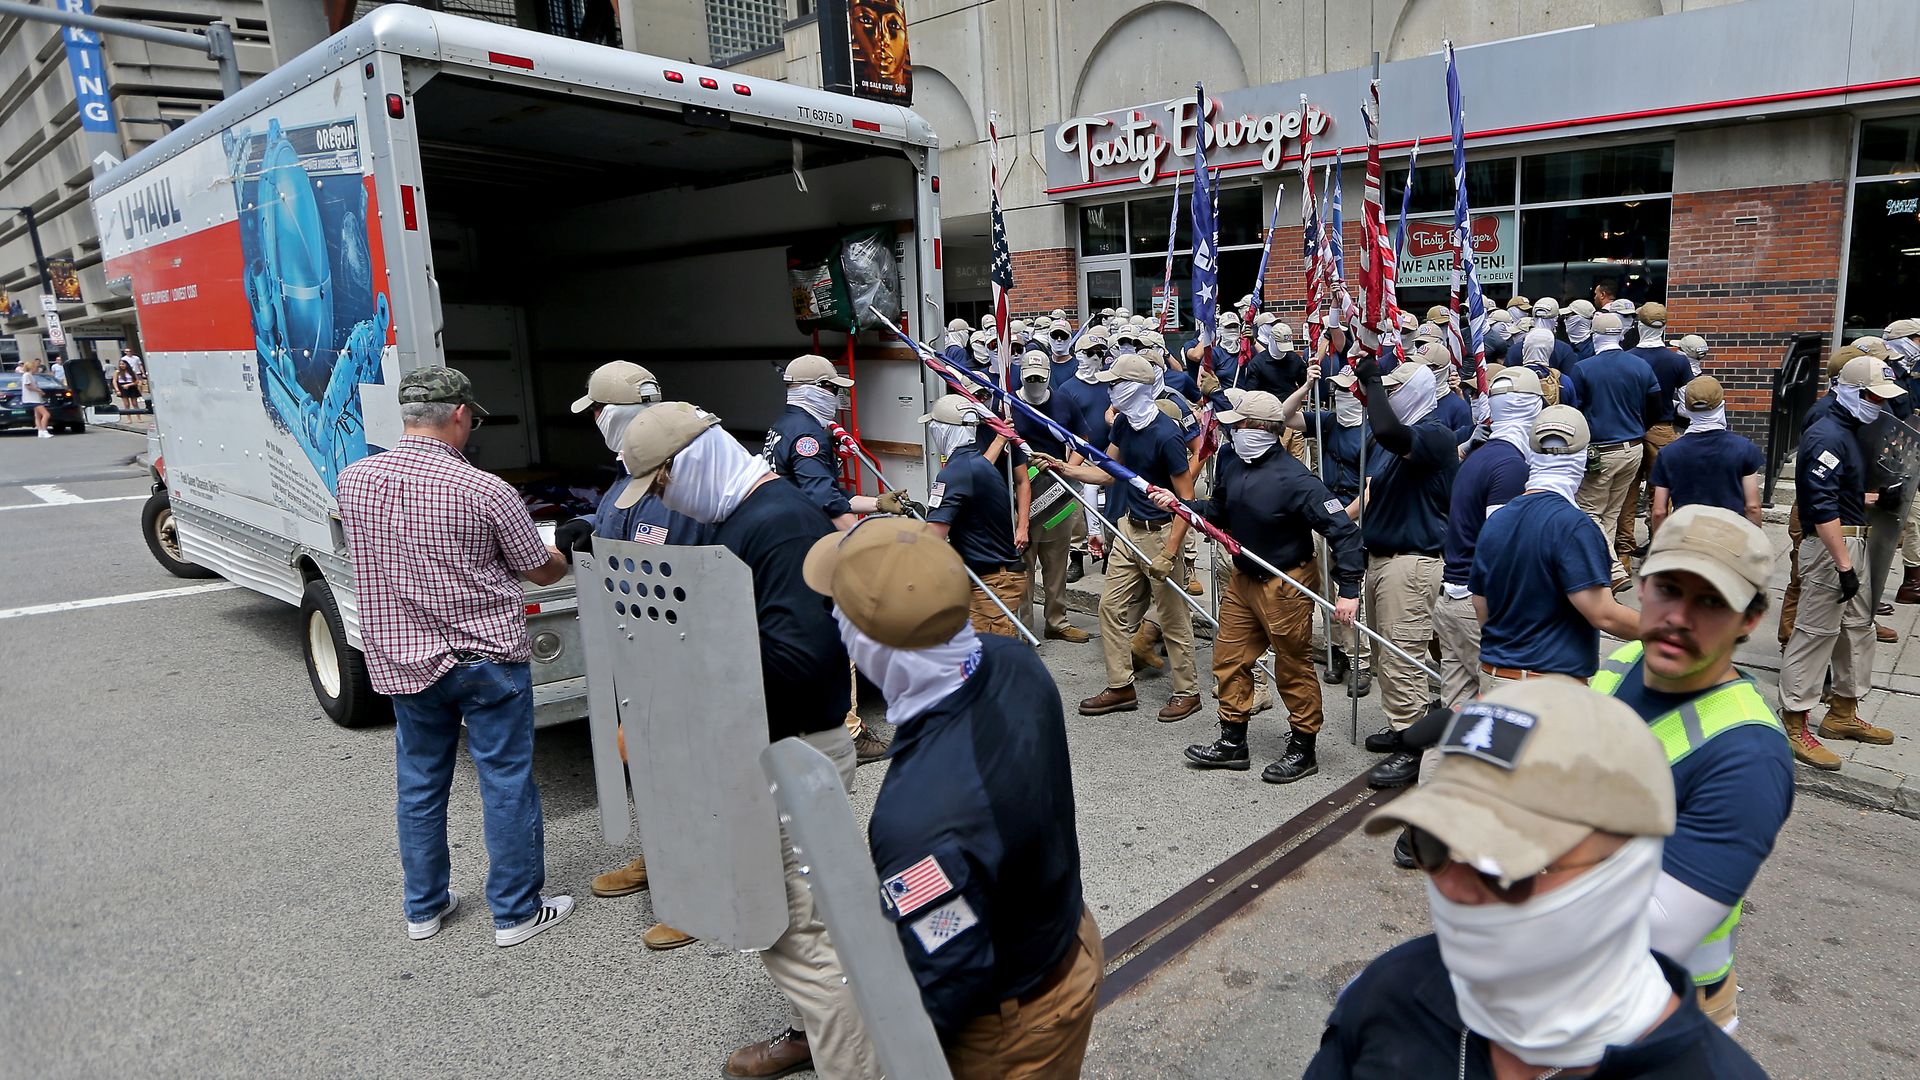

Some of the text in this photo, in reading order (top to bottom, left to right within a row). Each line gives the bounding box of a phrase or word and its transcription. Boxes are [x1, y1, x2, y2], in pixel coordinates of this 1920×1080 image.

[797, 106, 844, 125] TT 6375 D
[316, 125, 356, 150] OREGON
[1055, 96, 1328, 185] Tasty Burger
[1412, 228, 1492, 250] Tasty Bger
[1401, 260, 1423, 274] WE
[1427, 258, 1454, 273] ARE
[1419, 275, 1436, 284] DINE
[1489, 272, 1514, 281] DELIVE
[187, 284, 198, 299] COST
